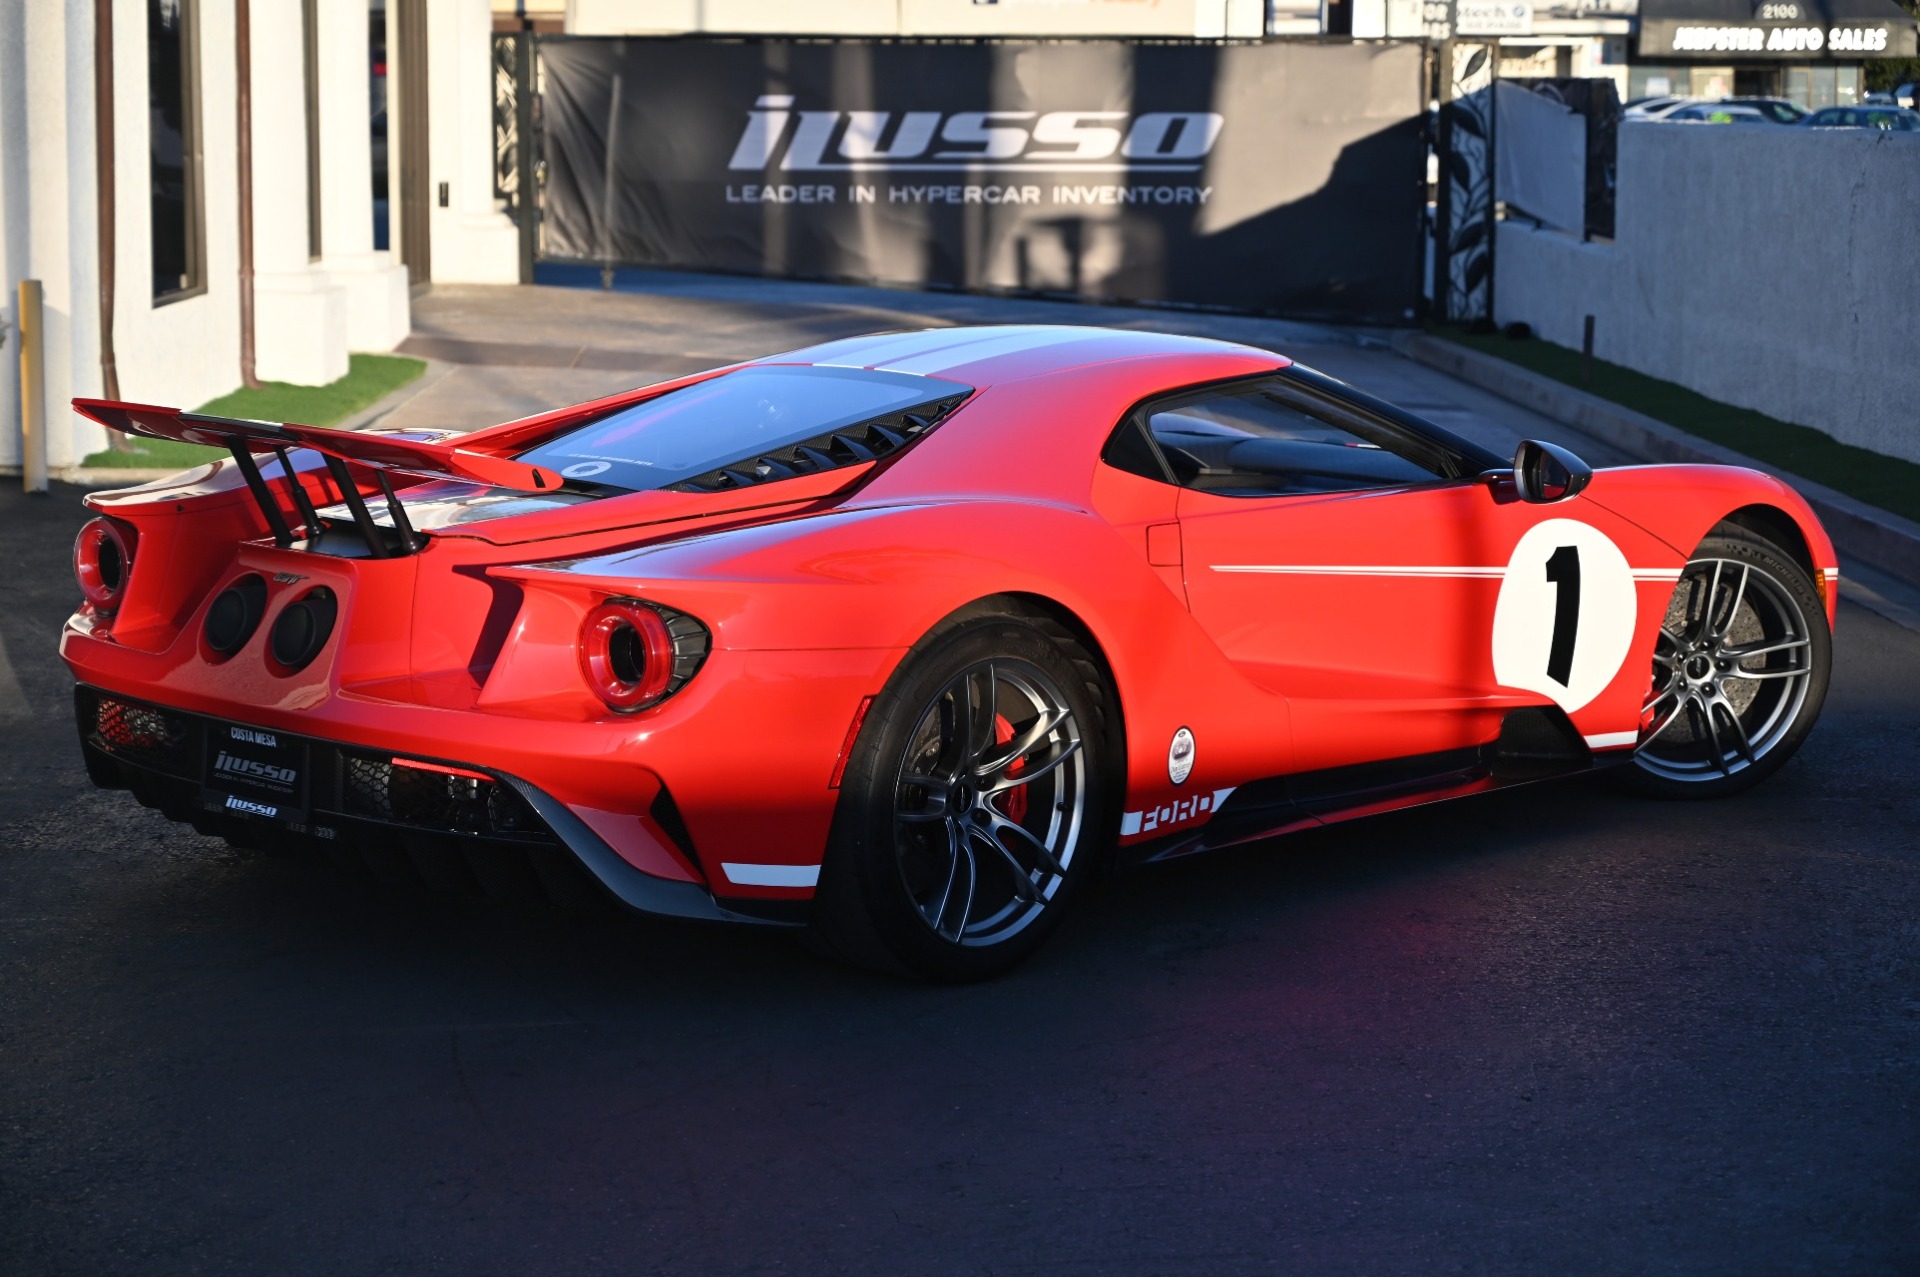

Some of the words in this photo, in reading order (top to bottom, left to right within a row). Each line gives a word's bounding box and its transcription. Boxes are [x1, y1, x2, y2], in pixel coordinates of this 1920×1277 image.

[1762, 4, 1798, 19] 2100
[1767, 28, 1824, 50] AUTO
[1828, 28, 1888, 50] SALES
[726, 185, 836, 203] LEADER
[849, 185, 876, 203] IN
[889, 185, 1041, 204] HYPERCAR
[1053, 186, 1213, 204] INVENTORY
[1762, 556, 1807, 596] MICHELIN
[1546, 545, 1581, 688] 1
[230, 727, 254, 743] COSTA
[255, 732, 277, 748] MESA
[1138, 791, 1215, 834] FORD
